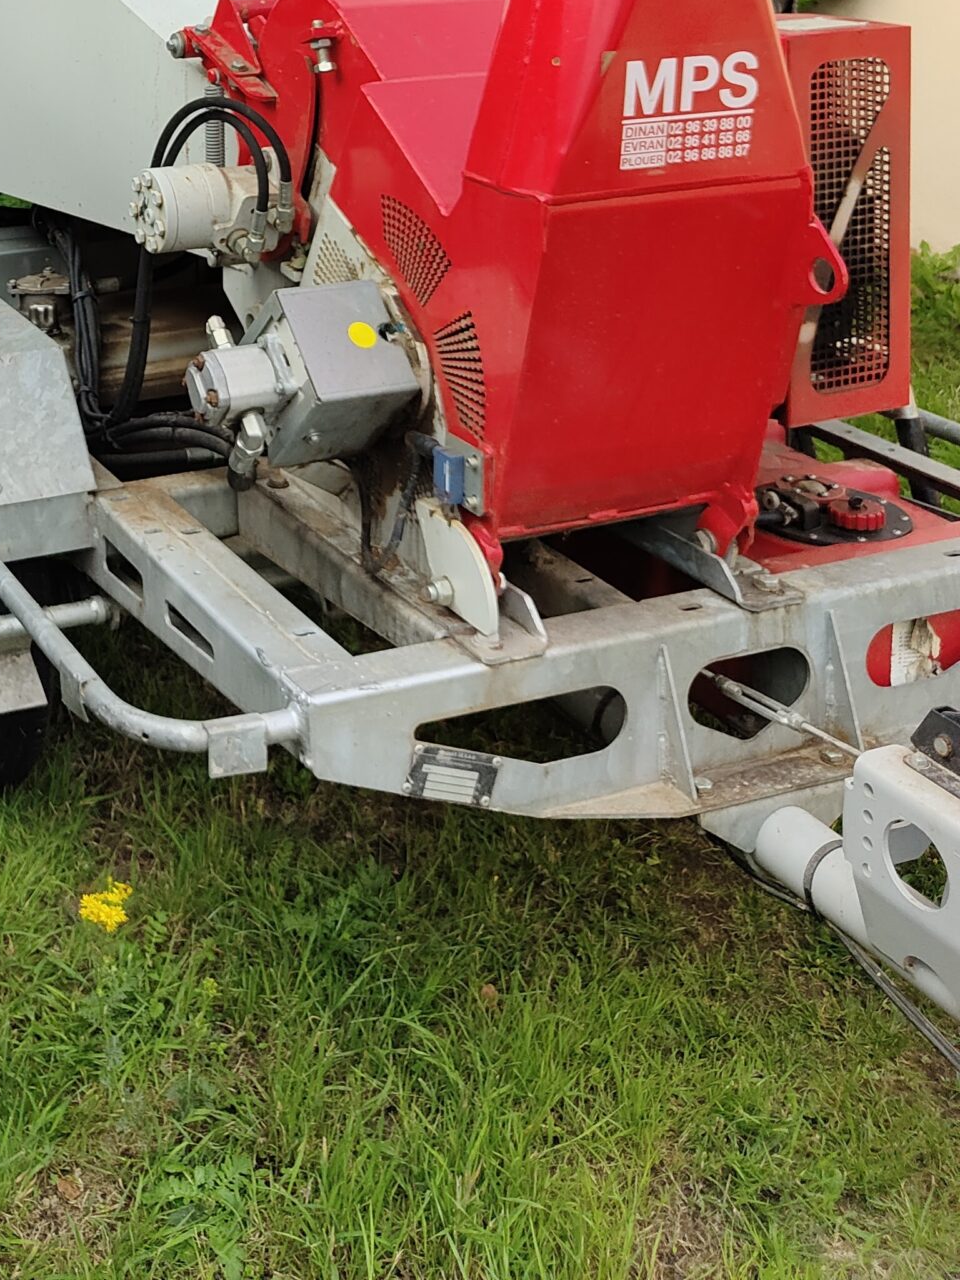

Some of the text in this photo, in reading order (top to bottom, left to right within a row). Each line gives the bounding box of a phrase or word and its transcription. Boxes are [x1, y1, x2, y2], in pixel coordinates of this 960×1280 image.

[623, 51, 759, 117] MPS
[625, 124, 665, 137] DINAN
[668, 121, 683, 135] 02
[685, 120, 700, 133] 96
[702, 119, 718, 131] 39
[623, 139, 664, 153] EVRAN
[667, 136, 682, 150] 02
[684, 135, 699, 148] 96
[701, 134, 716, 146] 41
[718, 132, 734, 144] 55
[621, 154, 664, 168] PLOUER
[666, 150, 682, 164] 02
[684, 149, 699, 162] 96
